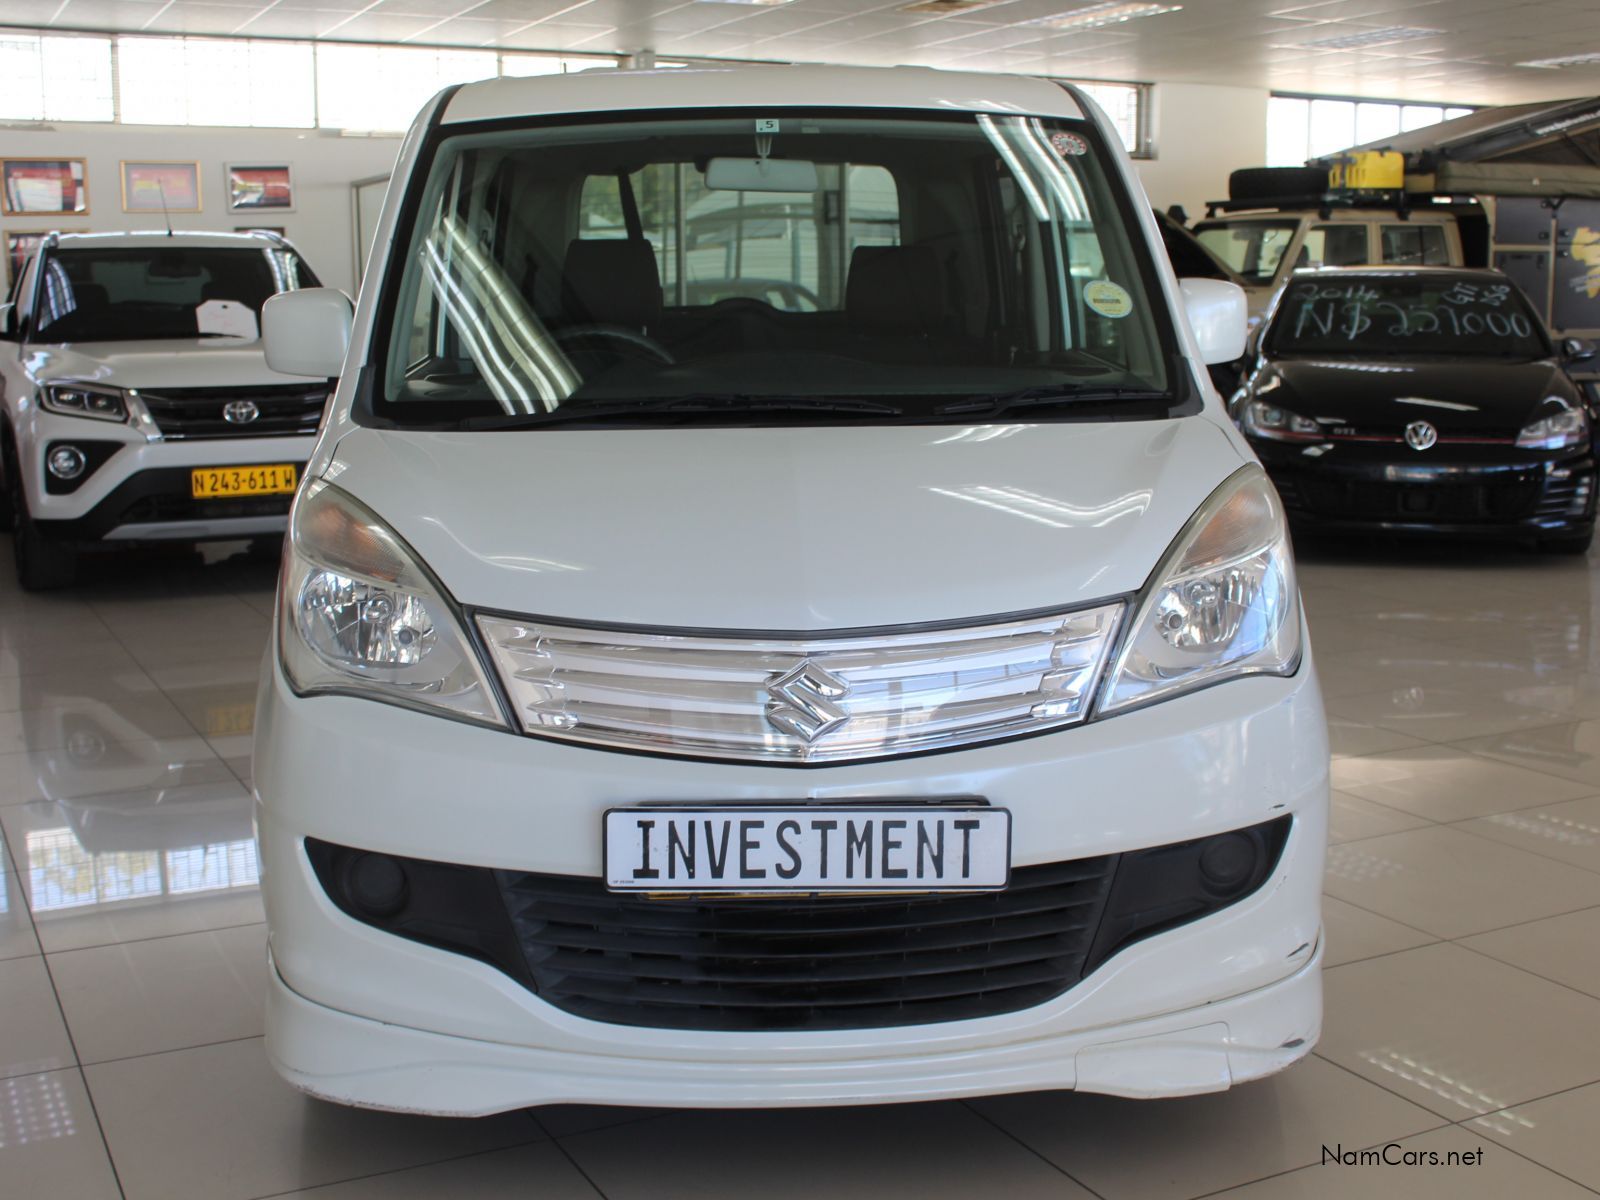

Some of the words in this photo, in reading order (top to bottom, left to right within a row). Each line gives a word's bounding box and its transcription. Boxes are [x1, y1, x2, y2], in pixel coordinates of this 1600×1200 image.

[1293, 282, 1379, 302] 2014
[194, 474, 204, 492] N
[210, 470, 278, 492] 243-611
[284, 469, 293, 488] W
[633, 819, 980, 879] INVESTMENT
